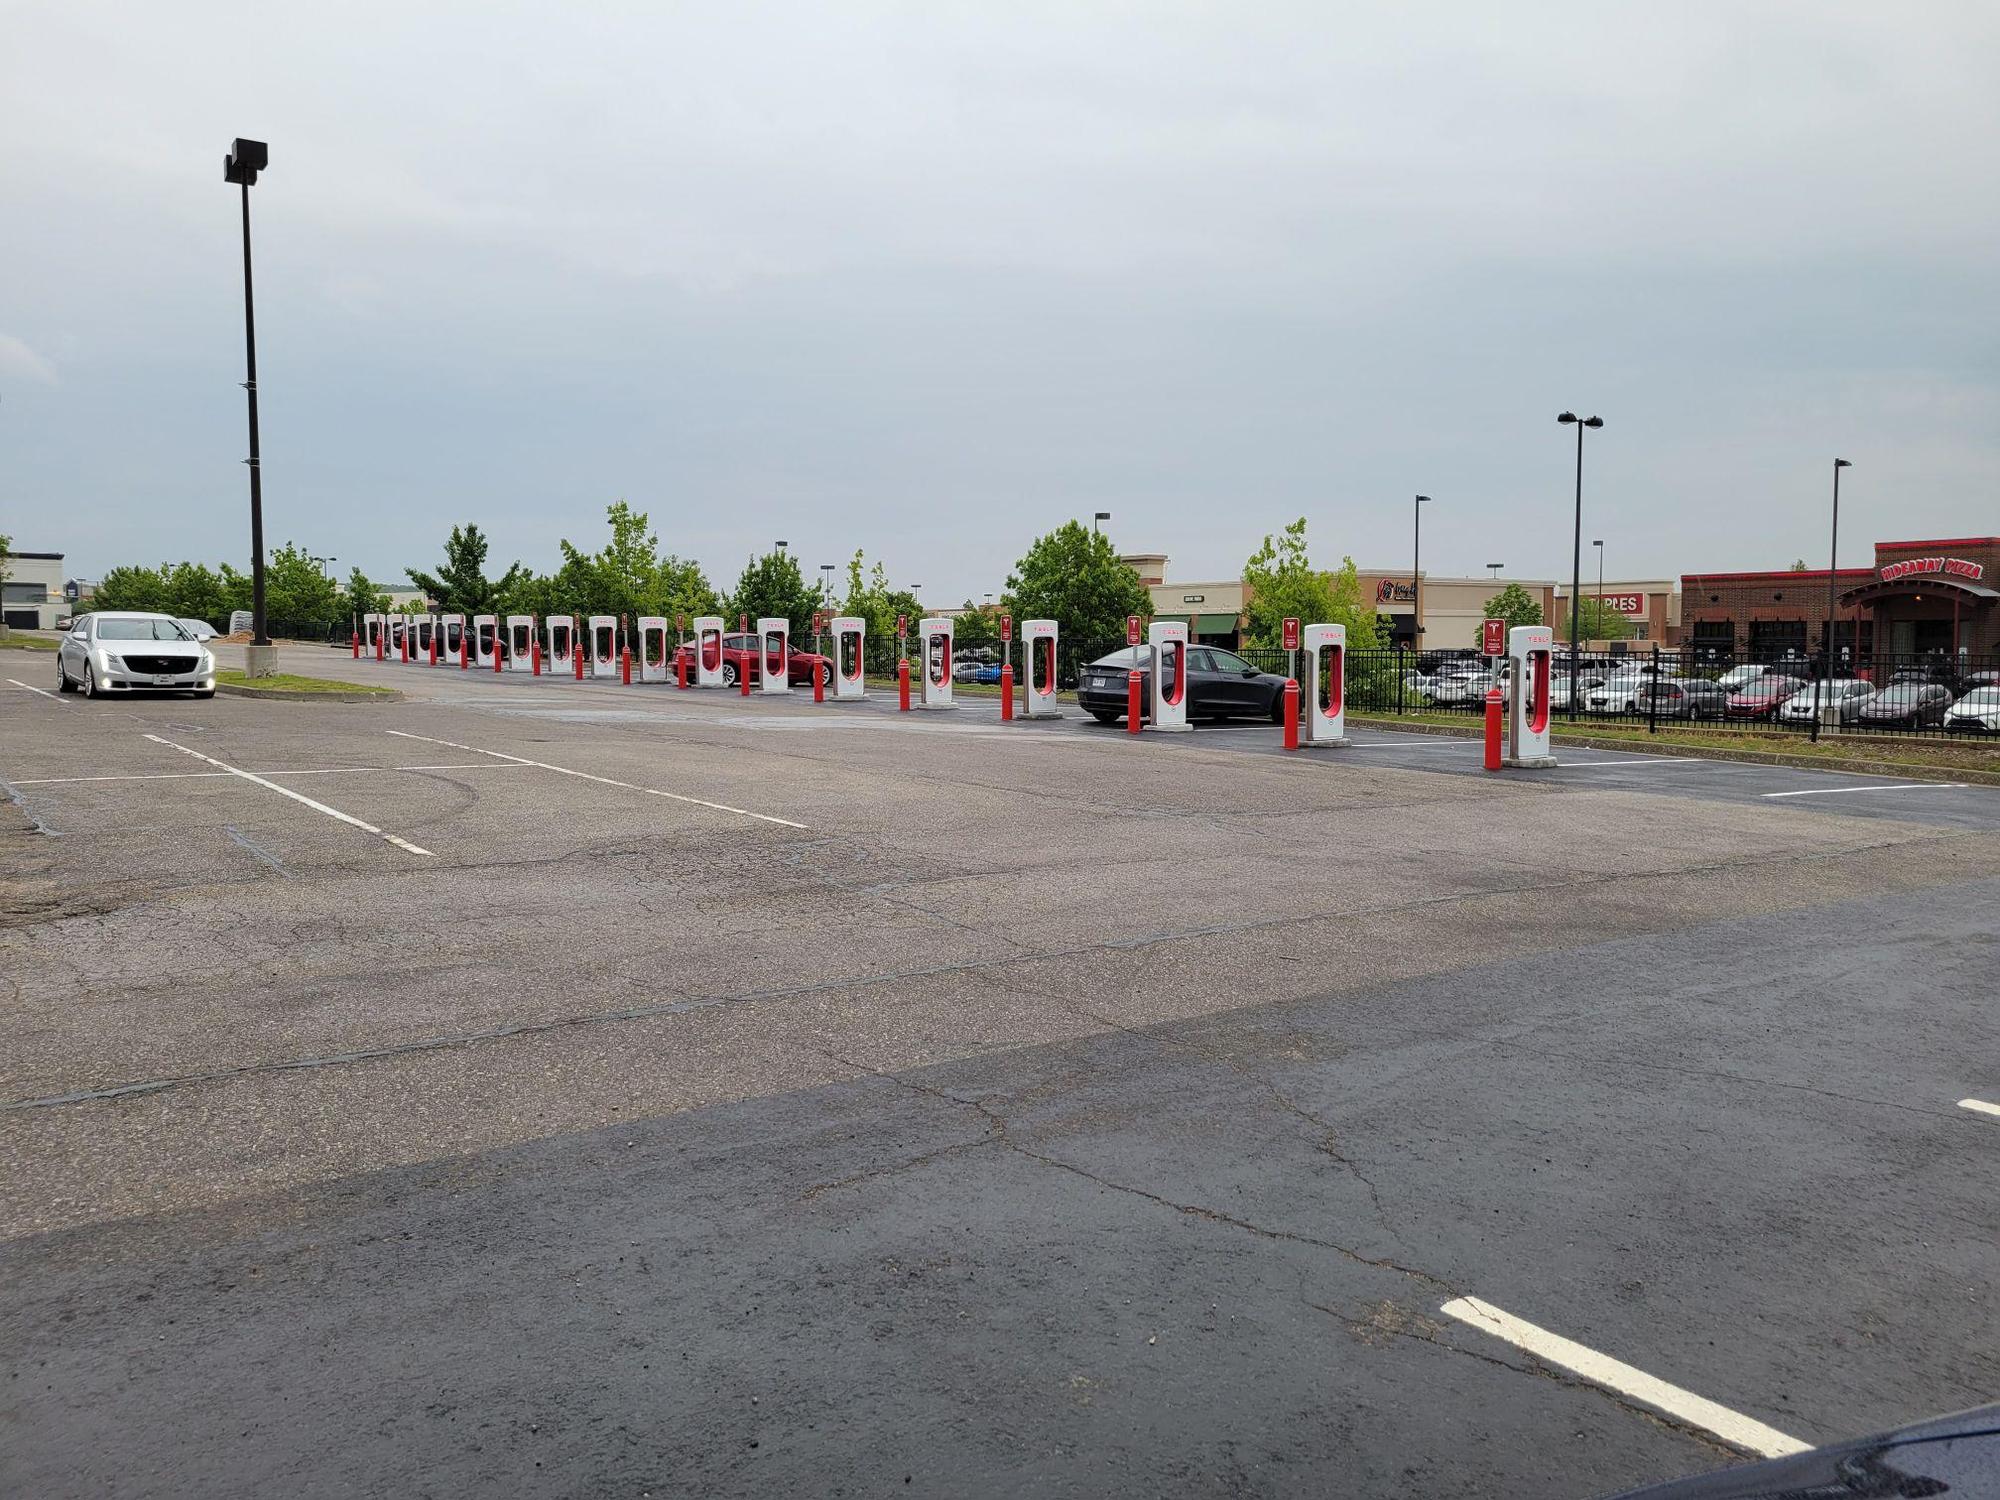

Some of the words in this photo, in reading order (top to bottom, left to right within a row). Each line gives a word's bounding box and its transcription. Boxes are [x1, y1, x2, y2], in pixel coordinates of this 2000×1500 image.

[1881, 557, 1945, 581] HIDEAWAY
[1945, 558, 1983, 579] PIZZA
[1527, 635, 1549, 643] TESLA
